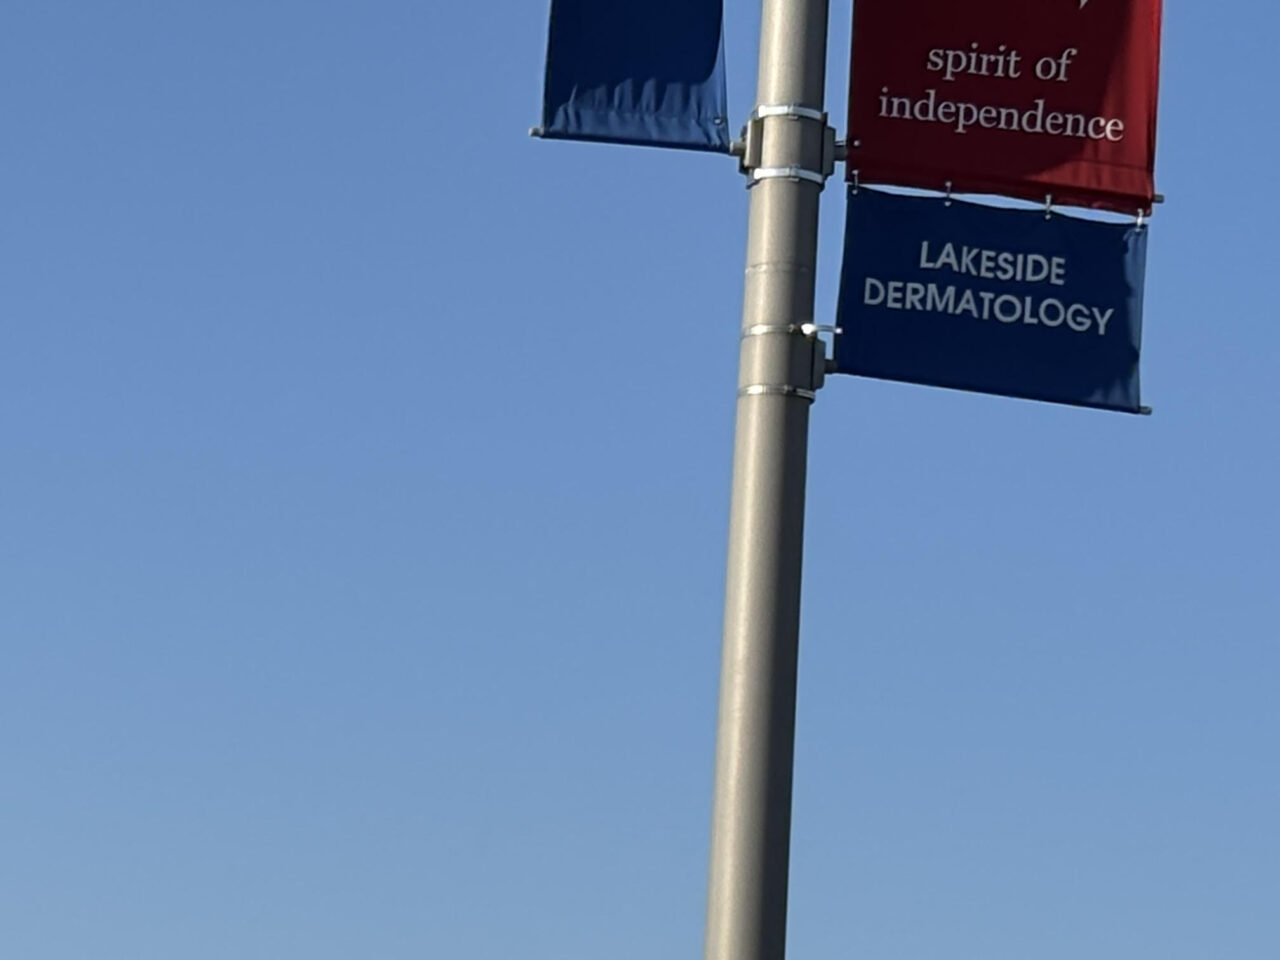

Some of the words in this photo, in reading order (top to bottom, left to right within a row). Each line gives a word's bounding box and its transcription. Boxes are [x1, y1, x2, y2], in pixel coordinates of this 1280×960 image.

[926, 42, 1022, 82] spirit
[1035, 47, 1078, 82] of
[879, 86, 1125, 142] independence
[919, 240, 1066, 285] LAKESIDE
[864, 277, 1114, 335] DERMATOLOGY
